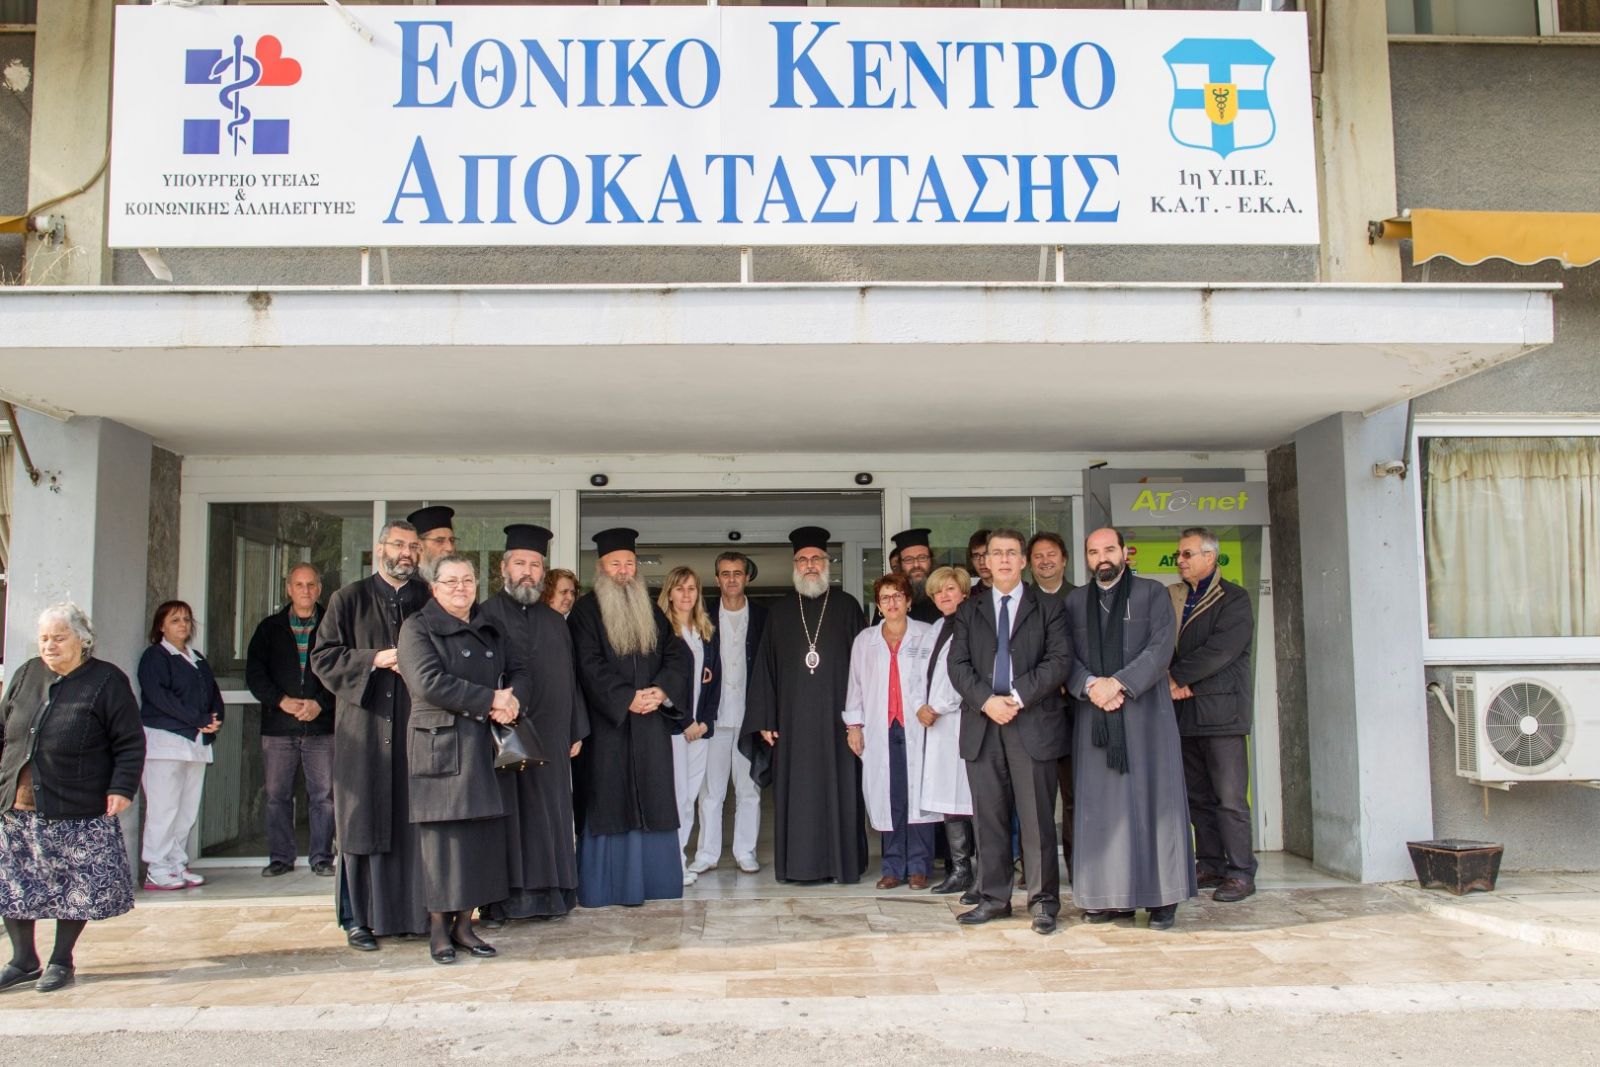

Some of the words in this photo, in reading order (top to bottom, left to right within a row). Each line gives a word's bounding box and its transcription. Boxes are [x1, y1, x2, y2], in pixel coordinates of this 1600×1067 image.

[393, 19, 721, 110] ΕΘΝΙΚΟ
[768, 20, 1117, 111] ΚΕΝΤΡΟ
[162, 174, 256, 187] ΥΠΟΥΡΓΕΙΟ
[261, 173, 320, 187] ΥΓΕΙΑΣ
[382, 135, 1121, 225] ΑΠΟΚΑΤΑΣΤΑΣΗΣ
[1178, 169, 1202, 190] 1η
[1208, 169, 1273, 186] Υ.Π.Ε.
[234, 188, 246, 201] &
[125, 201, 230, 215] ΚΟΙΝΩΝΙΚΗΣ
[234, 200, 356, 215] ΑΛΛΗΛΕΓΓΥΗΣ
